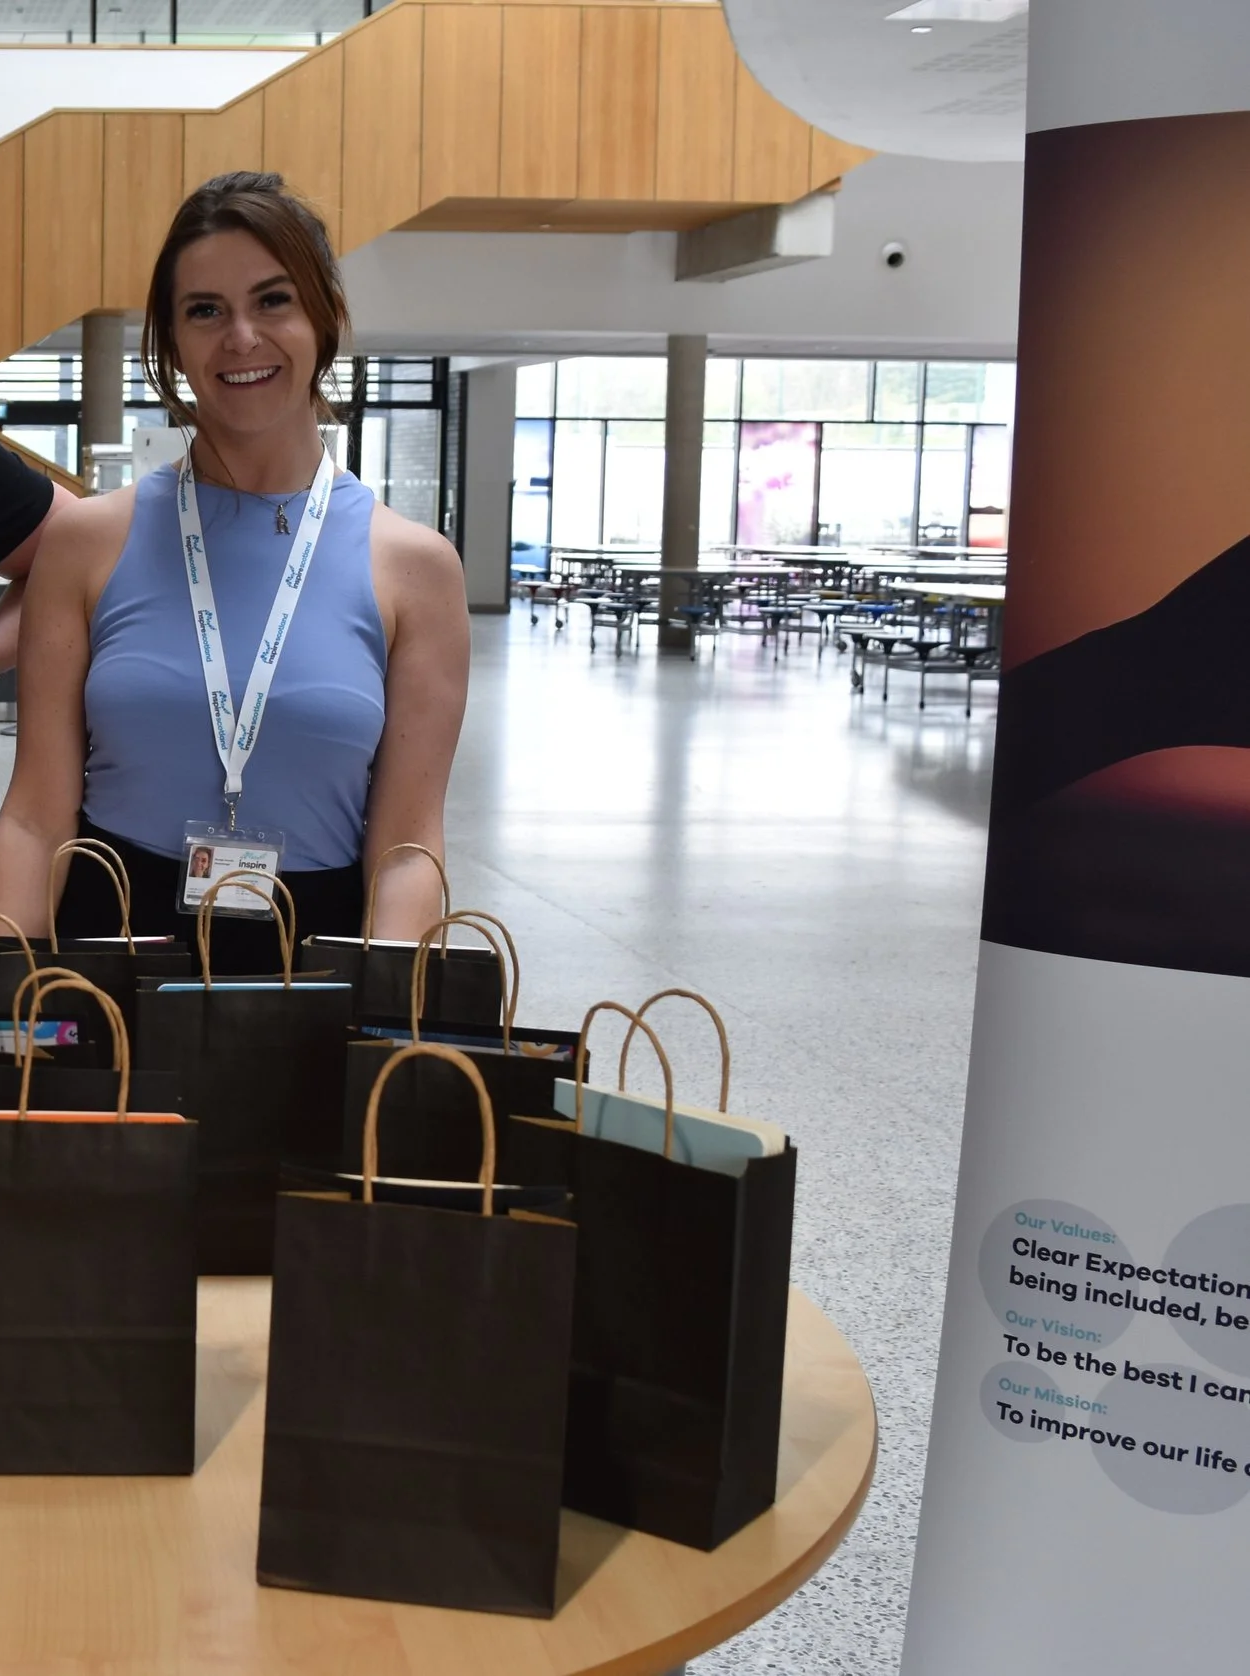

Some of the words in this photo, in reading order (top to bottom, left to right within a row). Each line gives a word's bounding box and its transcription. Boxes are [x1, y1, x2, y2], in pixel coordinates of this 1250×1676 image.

[238, 859, 267, 870] inspire
[1015, 1211, 1047, 1230] Our
[1050, 1219, 1116, 1245] Values:
[1012, 1237, 1079, 1267] Clear
[1085, 1252, 1250, 1300] Expectation
[1009, 1265, 1077, 1302] being
[1084, 1282, 1207, 1326] included,
[1215, 1306, 1249, 1331] be
[1005, 1310, 1037, 1328] Our
[1041, 1319, 1102, 1344] Vision:
[1003, 1333, 1030, 1357] To
[1037, 1341, 1067, 1366] be
[1073, 1352, 1117, 1377] the
[1123, 1360, 1183, 1391] best
[1189, 1374, 1197, 1393] I
[1203, 1381, 1250, 1404] can
[998, 1377, 1030, 1396] Our
[1034, 1385, 1108, 1415] Mission:
[996, 1400, 1023, 1424] To
[1030, 1409, 1136, 1451] improve
[1142, 1440, 1189, 1463] our
[1195, 1446, 1237, 1473] life
